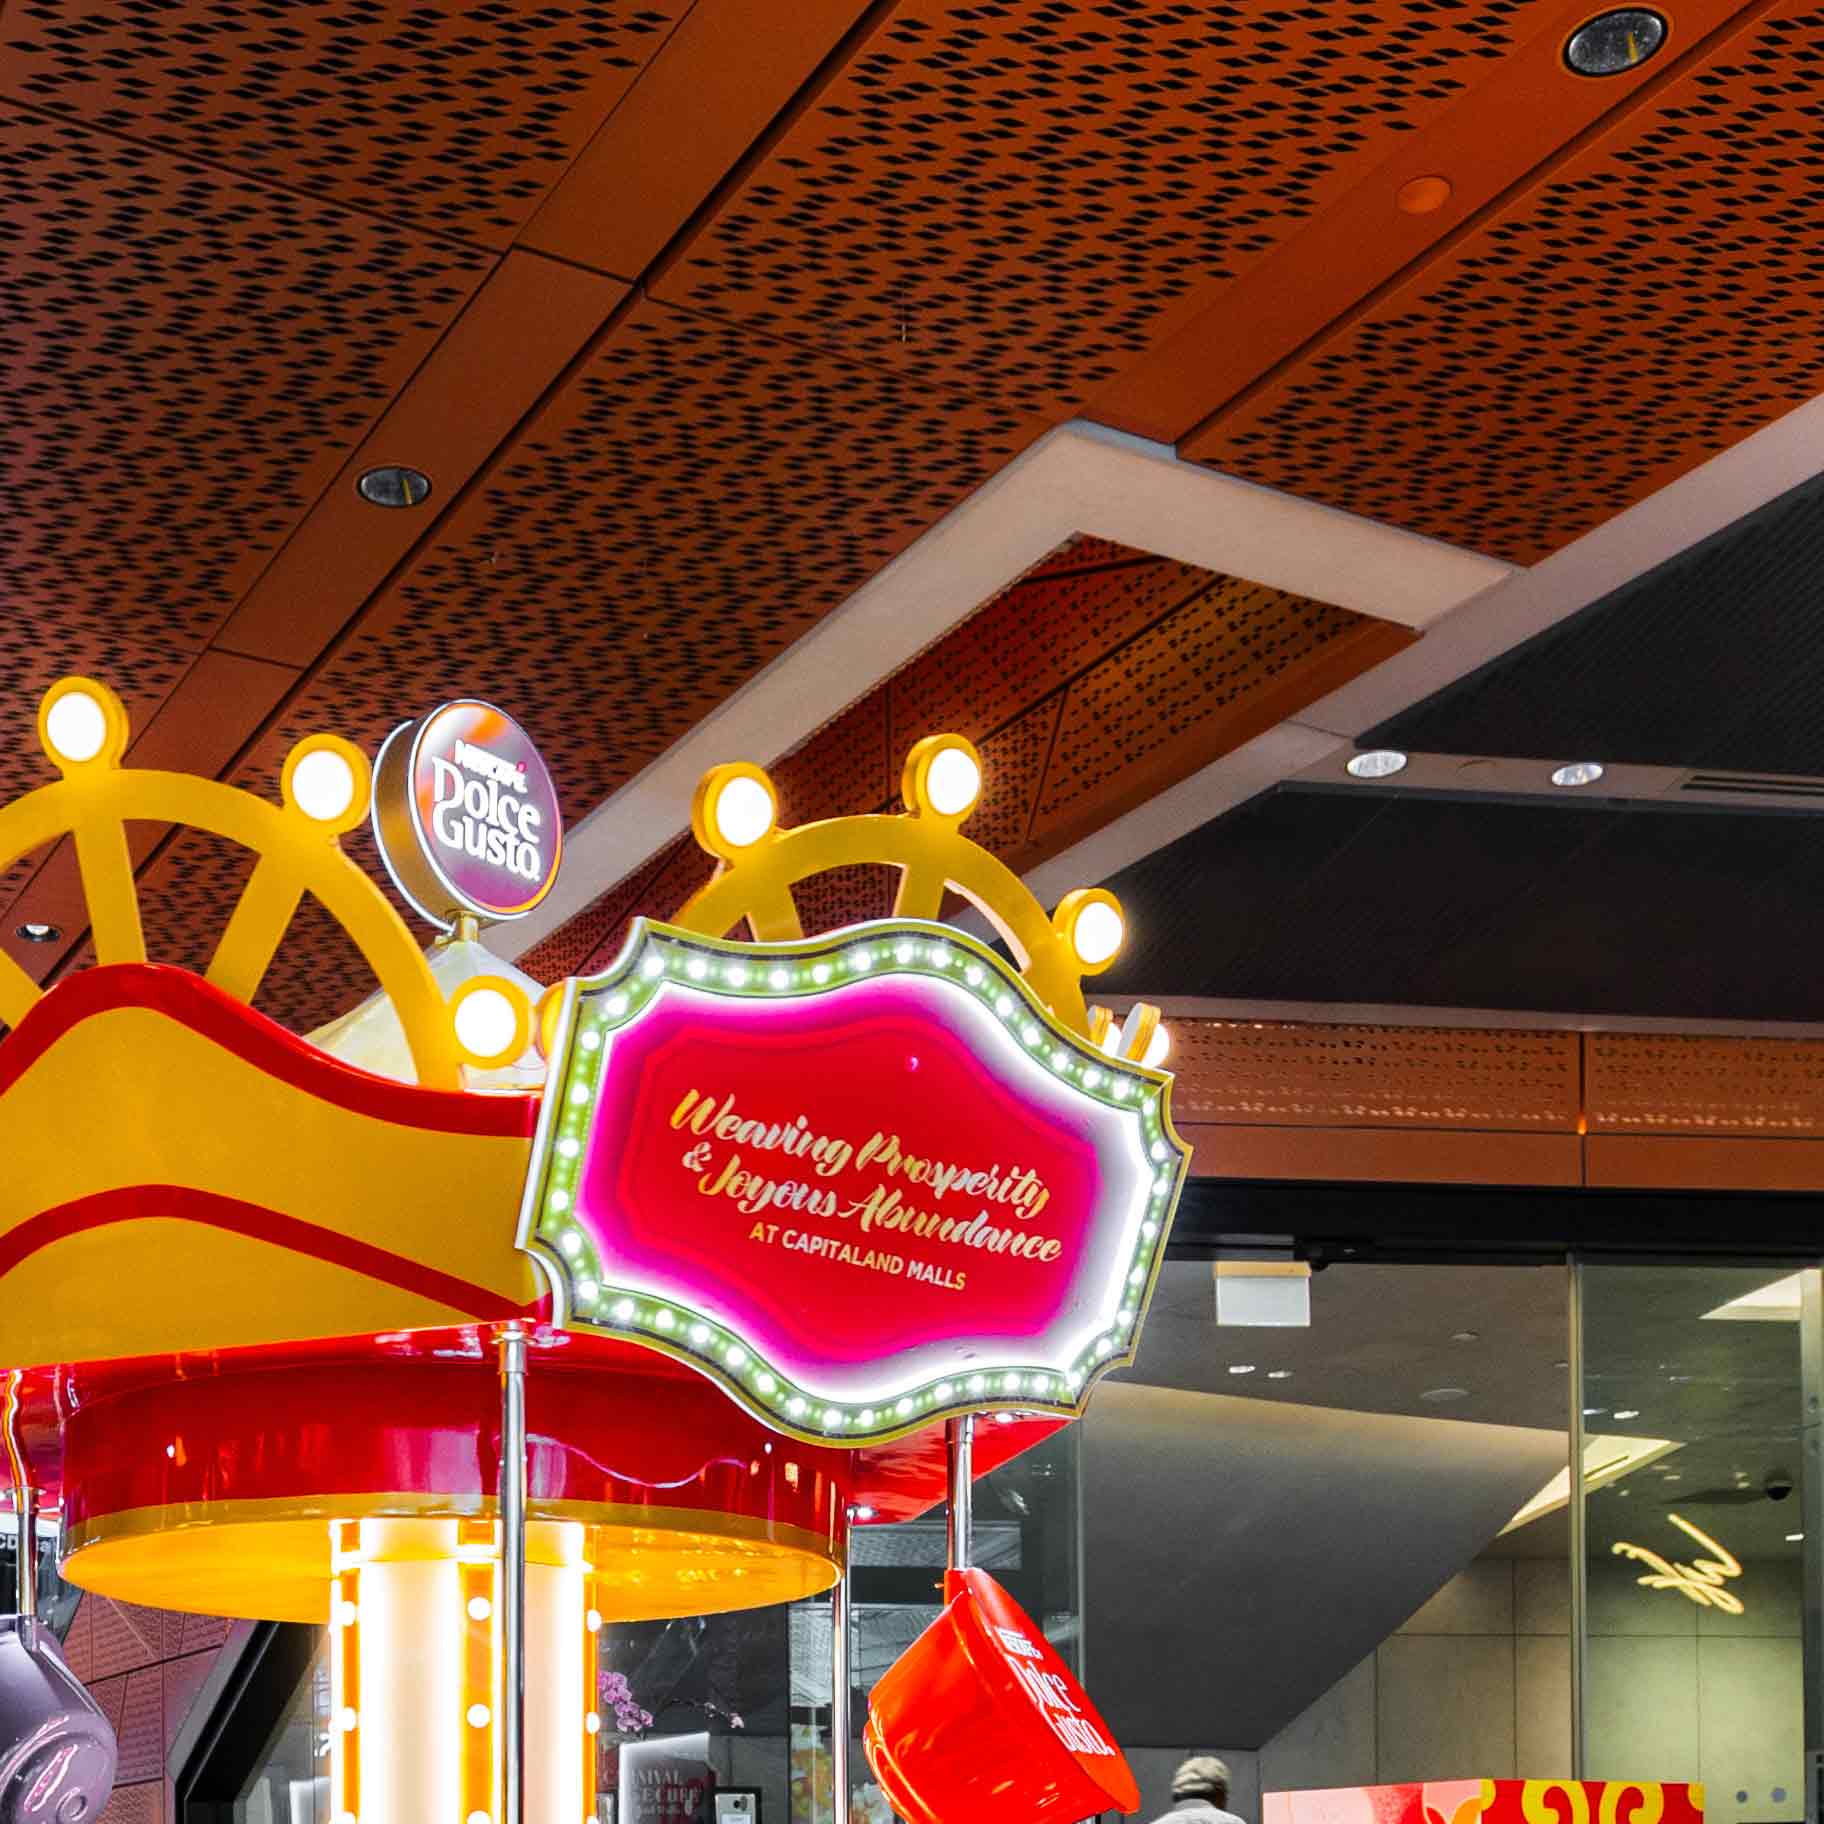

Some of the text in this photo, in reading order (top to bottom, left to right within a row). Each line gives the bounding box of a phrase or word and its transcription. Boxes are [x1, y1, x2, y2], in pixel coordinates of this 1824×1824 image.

[432, 757, 542, 842] Dolce
[670, 1088, 1052, 1220] Weaving Prosperity
[682, 1141, 1062, 1264] & Joyous Abundance
[749, 1221, 967, 1292] AT CAPITALAND MALLS
